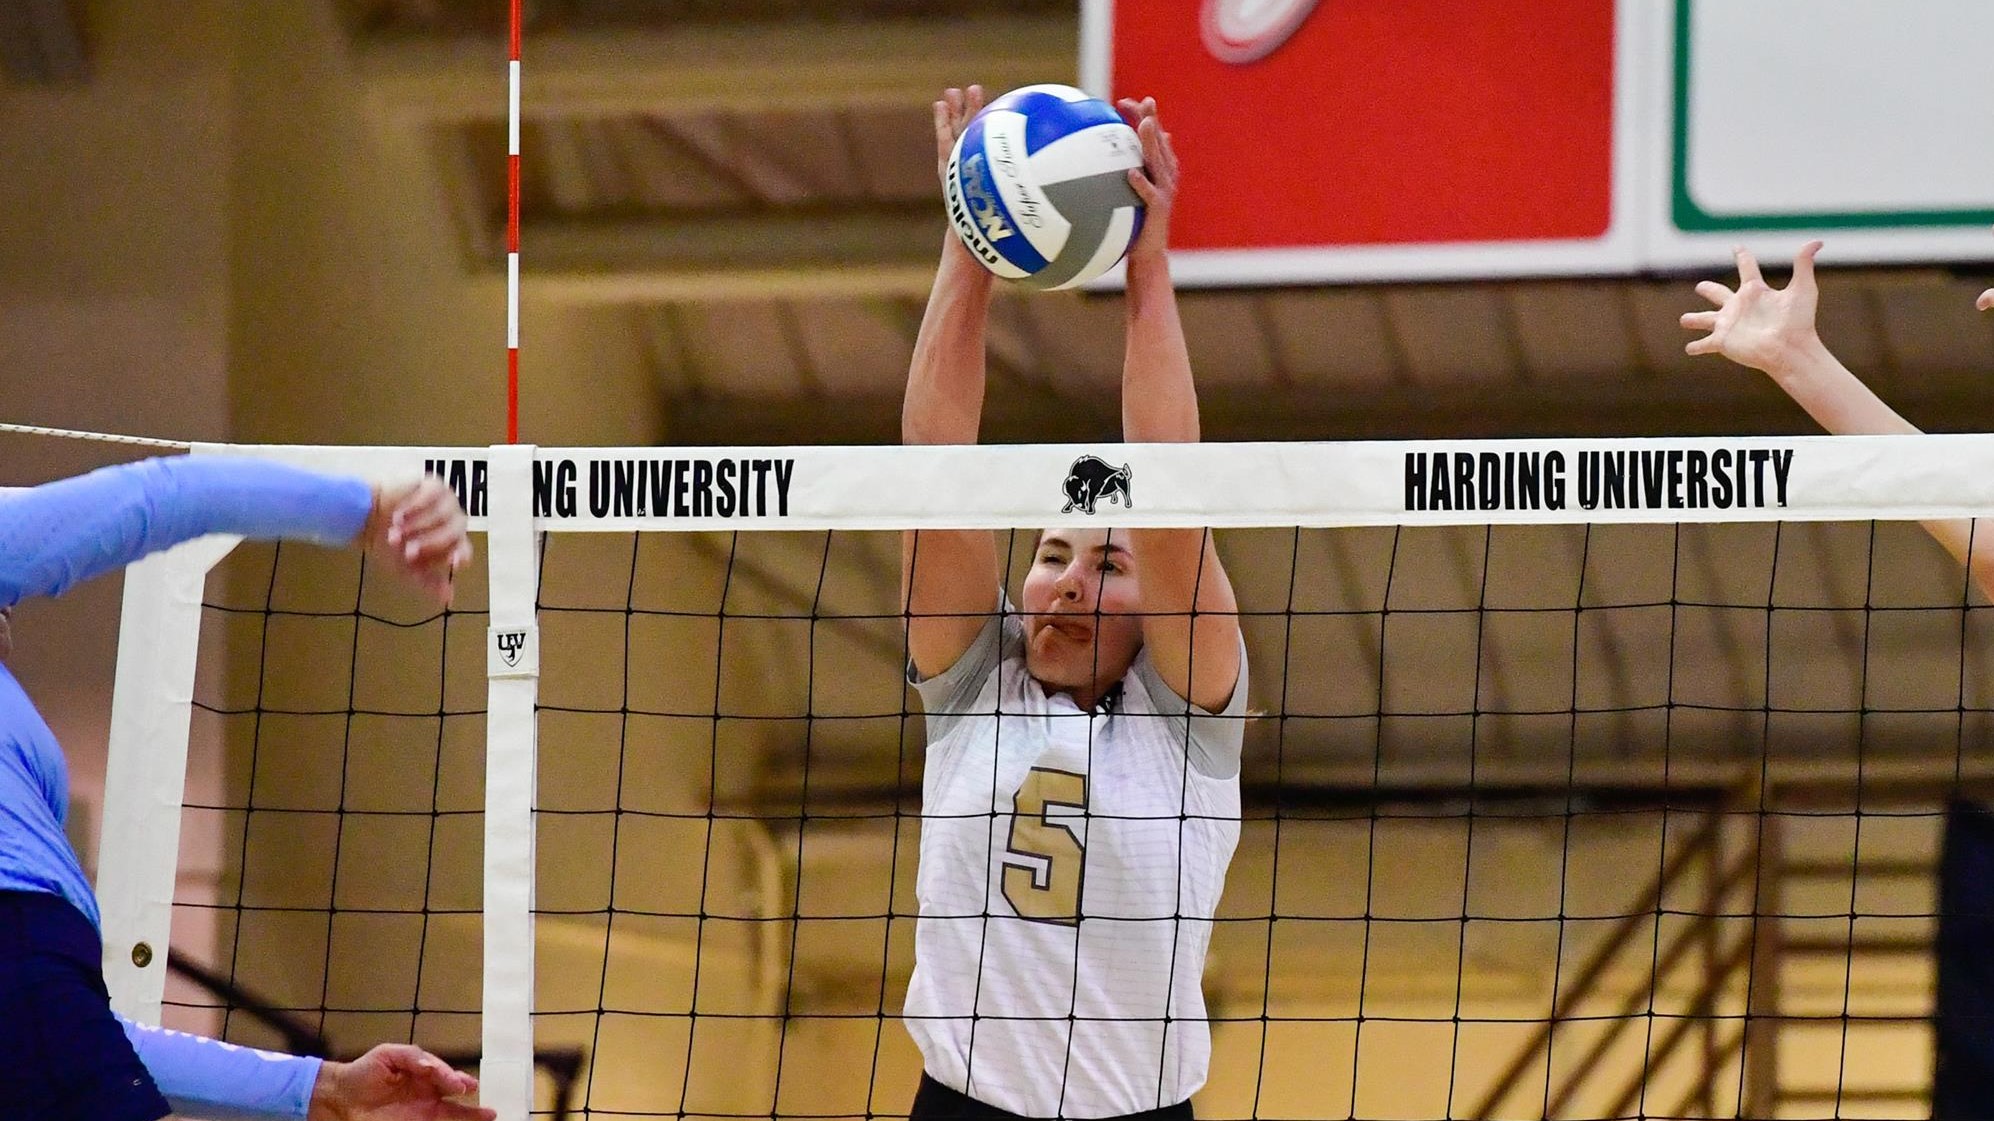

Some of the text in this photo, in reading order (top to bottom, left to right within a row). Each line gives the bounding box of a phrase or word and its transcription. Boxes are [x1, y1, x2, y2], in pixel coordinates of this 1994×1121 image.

[949, 161, 998, 264] molten
[961, 152, 1016, 242] NCAA
[1016, 184, 1042, 229] Super
[425, 458, 795, 518] ARNG UNIVERSITY
[1404, 448, 1794, 511] HARDING UNIVERSITY
[1000, 766, 1087, 928] 5
